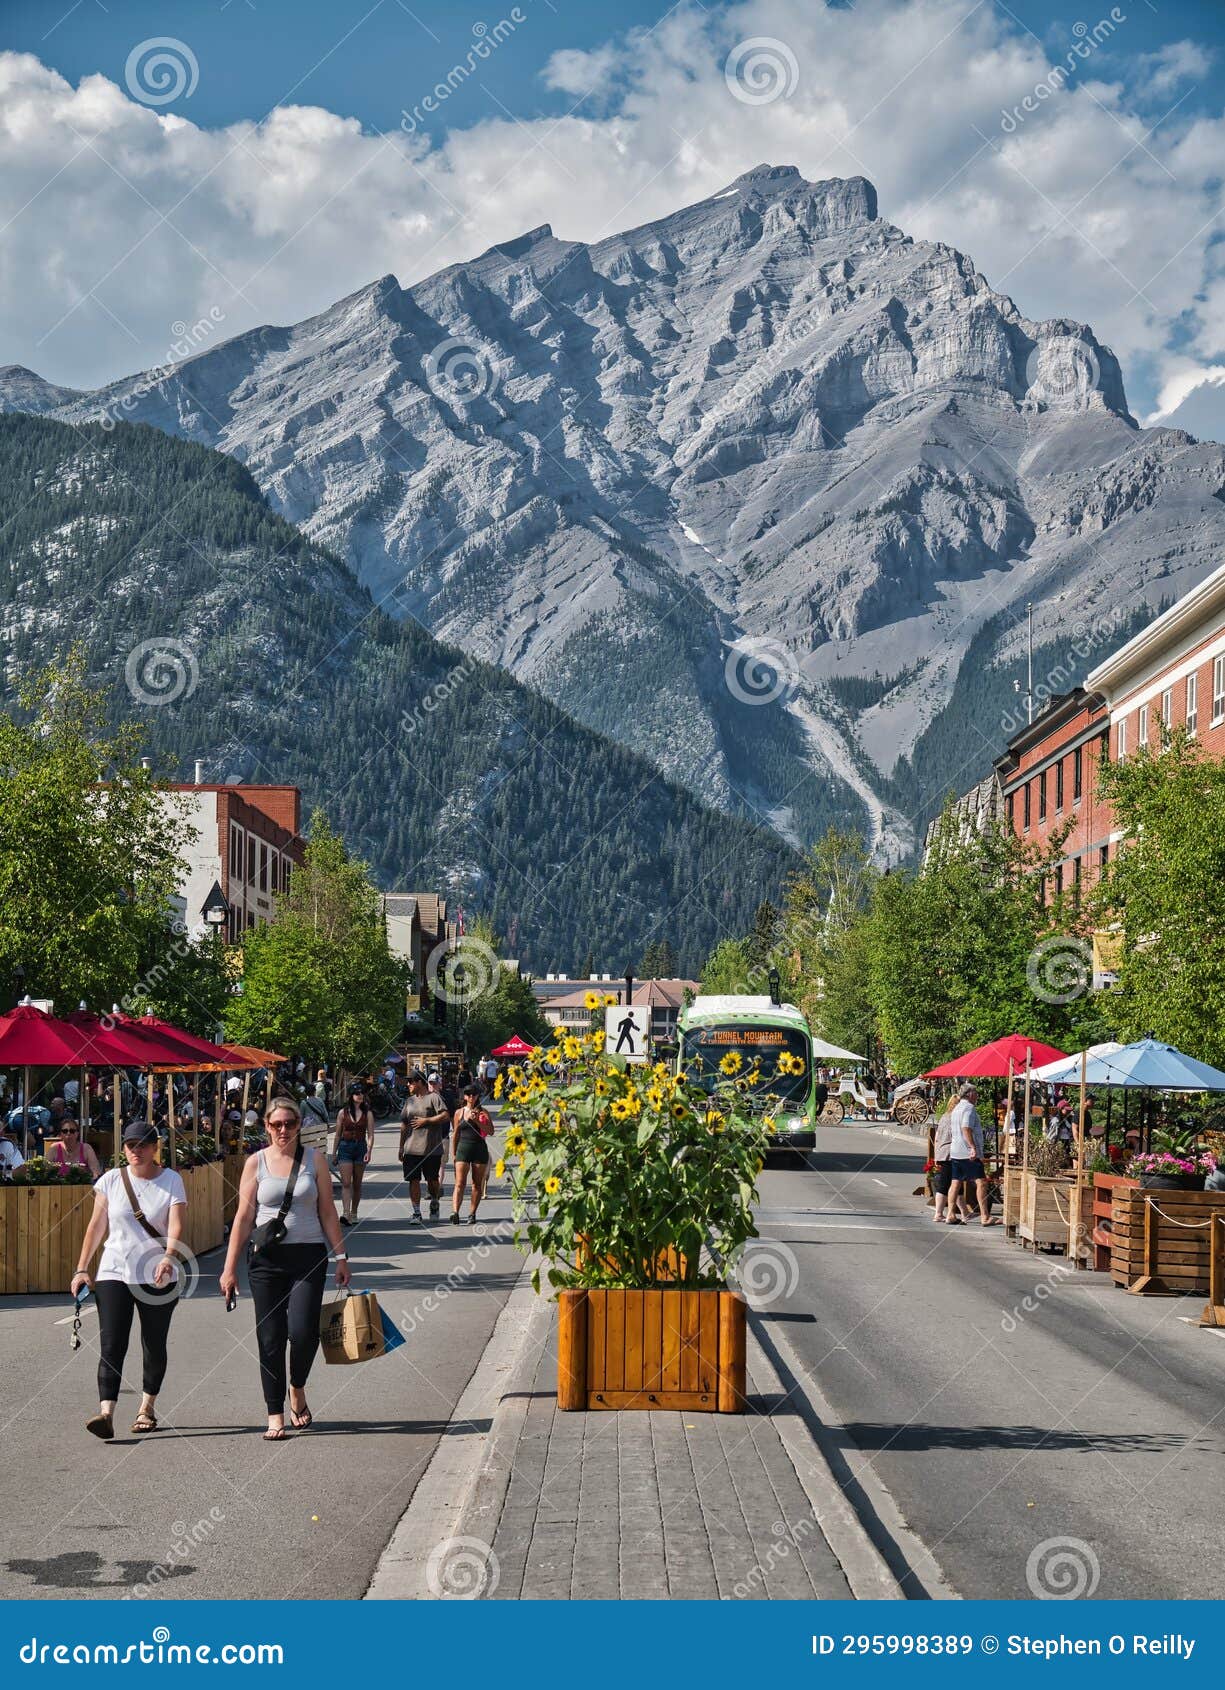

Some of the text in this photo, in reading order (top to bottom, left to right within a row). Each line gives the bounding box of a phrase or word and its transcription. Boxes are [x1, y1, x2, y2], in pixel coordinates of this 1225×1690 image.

[700, 1031, 707, 1044] 2
[713, 1031, 741, 1041] TUNNEL
[744, 1031, 783, 1041] MOUNTAIN
